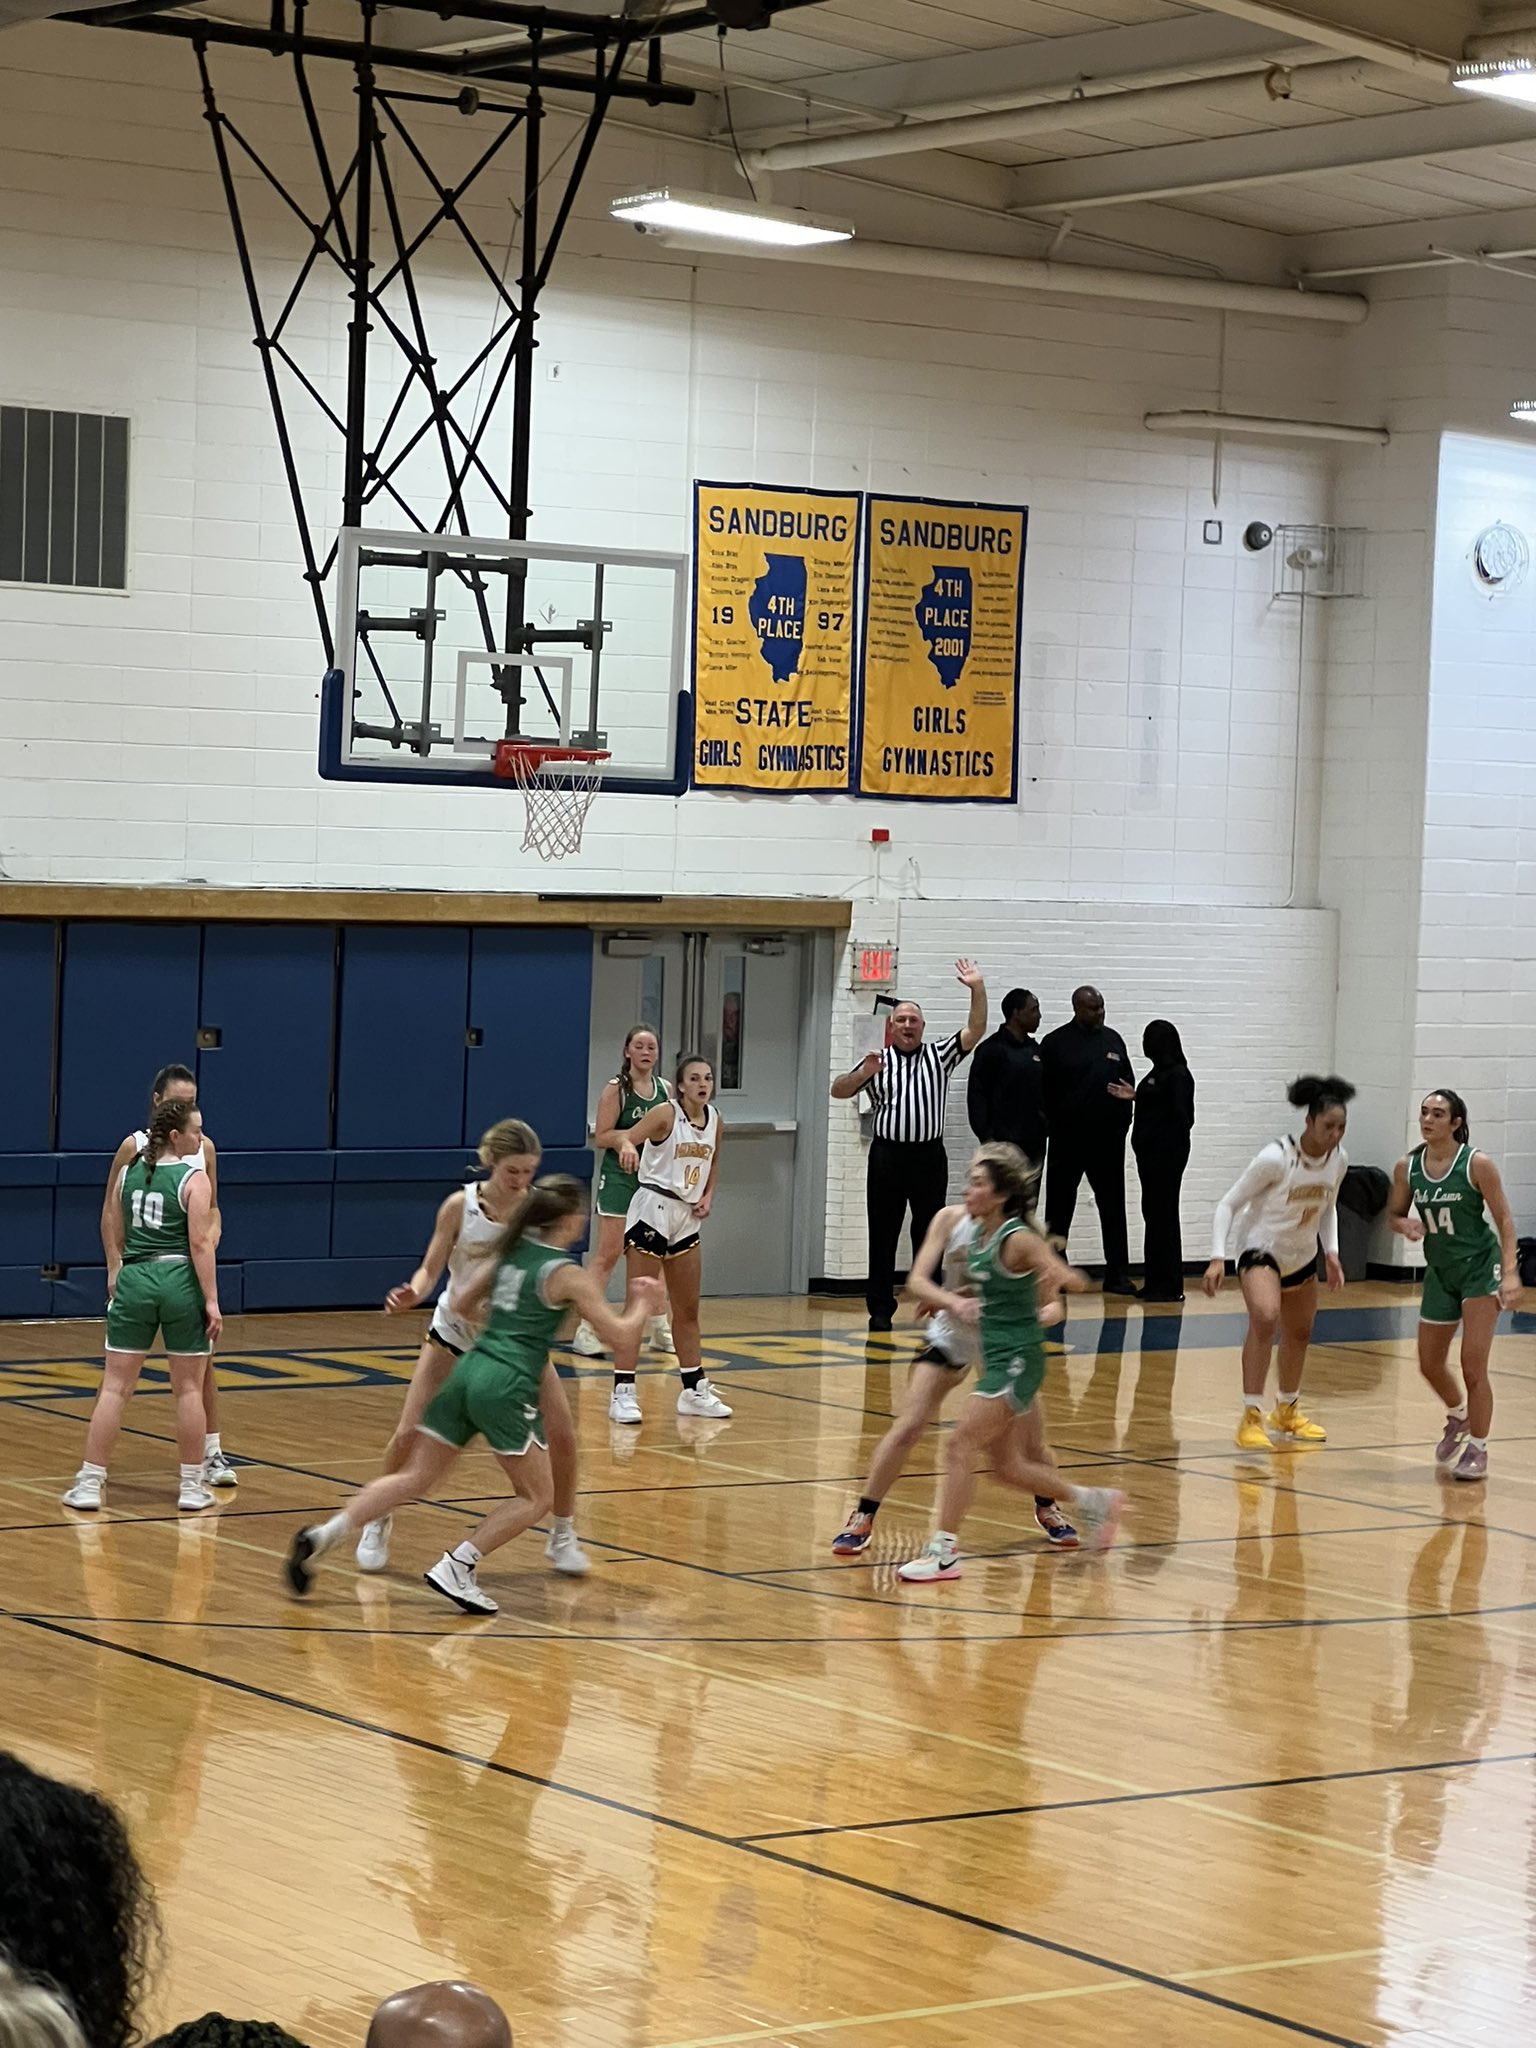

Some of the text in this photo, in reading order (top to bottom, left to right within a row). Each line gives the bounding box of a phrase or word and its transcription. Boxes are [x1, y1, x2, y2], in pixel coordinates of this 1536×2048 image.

[709, 505, 847, 542] SANDBURG
[880, 518, 1012, 554] SANDBURG
[934, 578, 962, 597] 4TH
[712, 606, 734, 625] 19
[767, 595, 795, 616] 4TH
[925, 608, 969, 629] PLACE
[758, 618, 801, 640] PLACE
[817, 613, 844, 631] 97
[935, 638, 963, 657] 2001
[735, 697, 812, 728] STATE
[913, 706, 966, 734] GIRLS
[699, 739, 845, 772] GIRLS GYMNASTICS
[883, 747, 993, 777] GYMNASTICS
[861, 950, 891, 981] EXIT
[1431, 1187, 1463, 1203] Lawn
[131, 1190, 164, 1229] 10
[1424, 1207, 1455, 1235] 14
